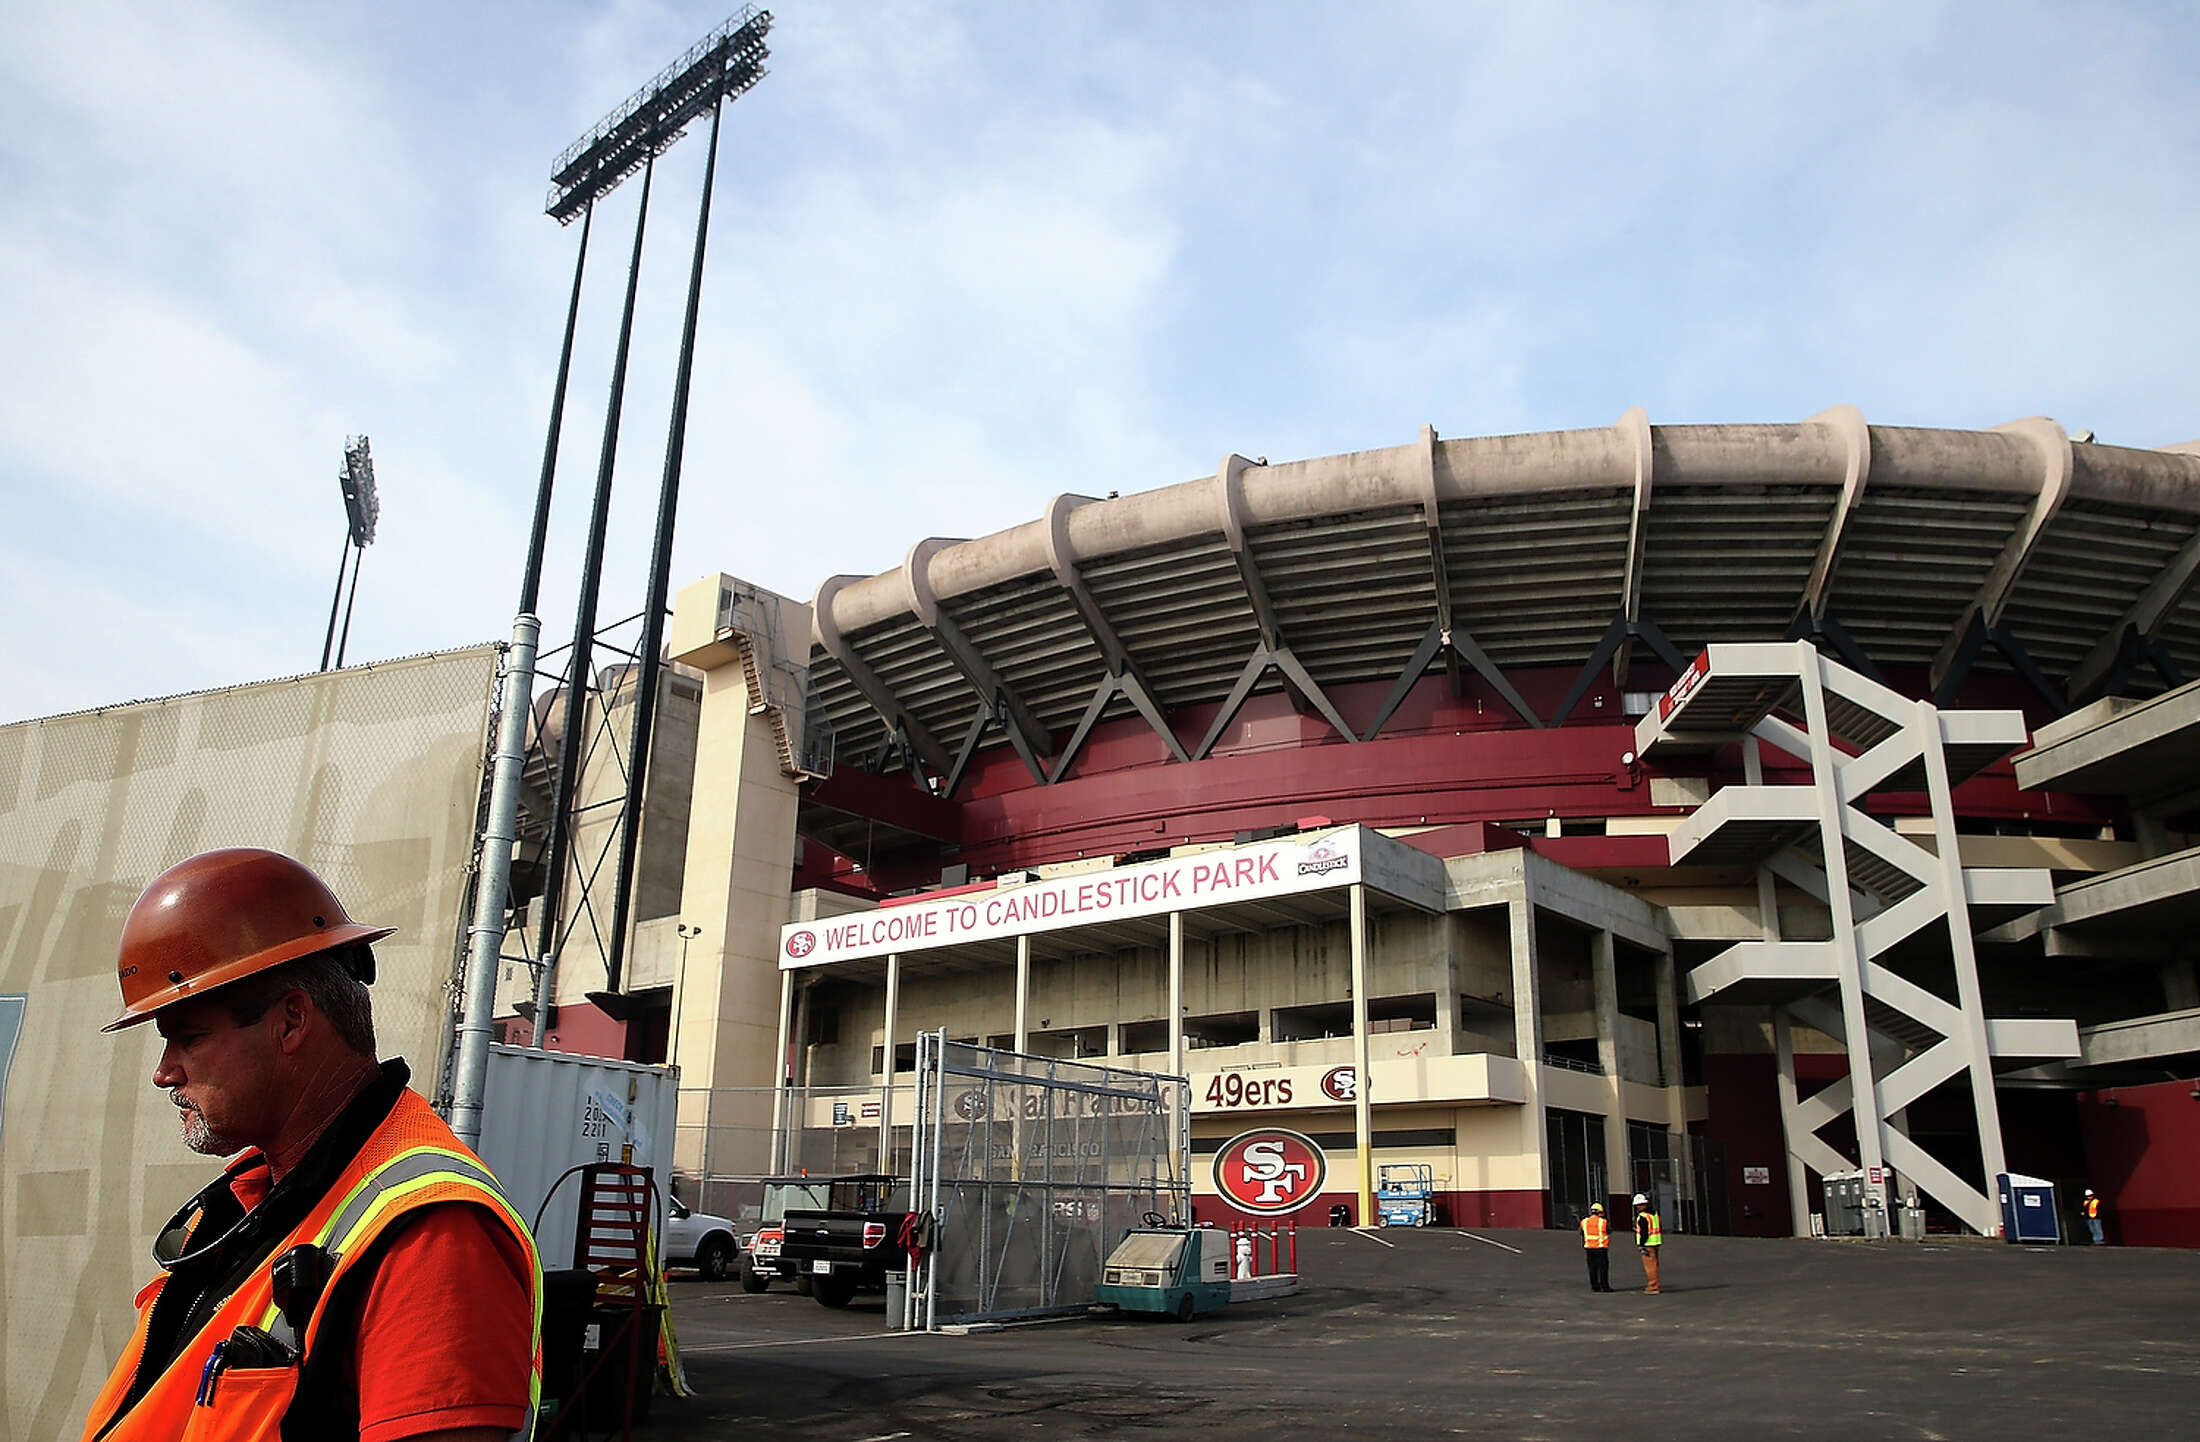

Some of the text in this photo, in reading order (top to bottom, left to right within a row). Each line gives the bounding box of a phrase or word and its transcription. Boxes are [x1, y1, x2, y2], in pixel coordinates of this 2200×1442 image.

[825, 852, 1280, 951] WELCOME TO CANDLESTICK PARK
[1205, 1073, 1293, 1107] 49ers
